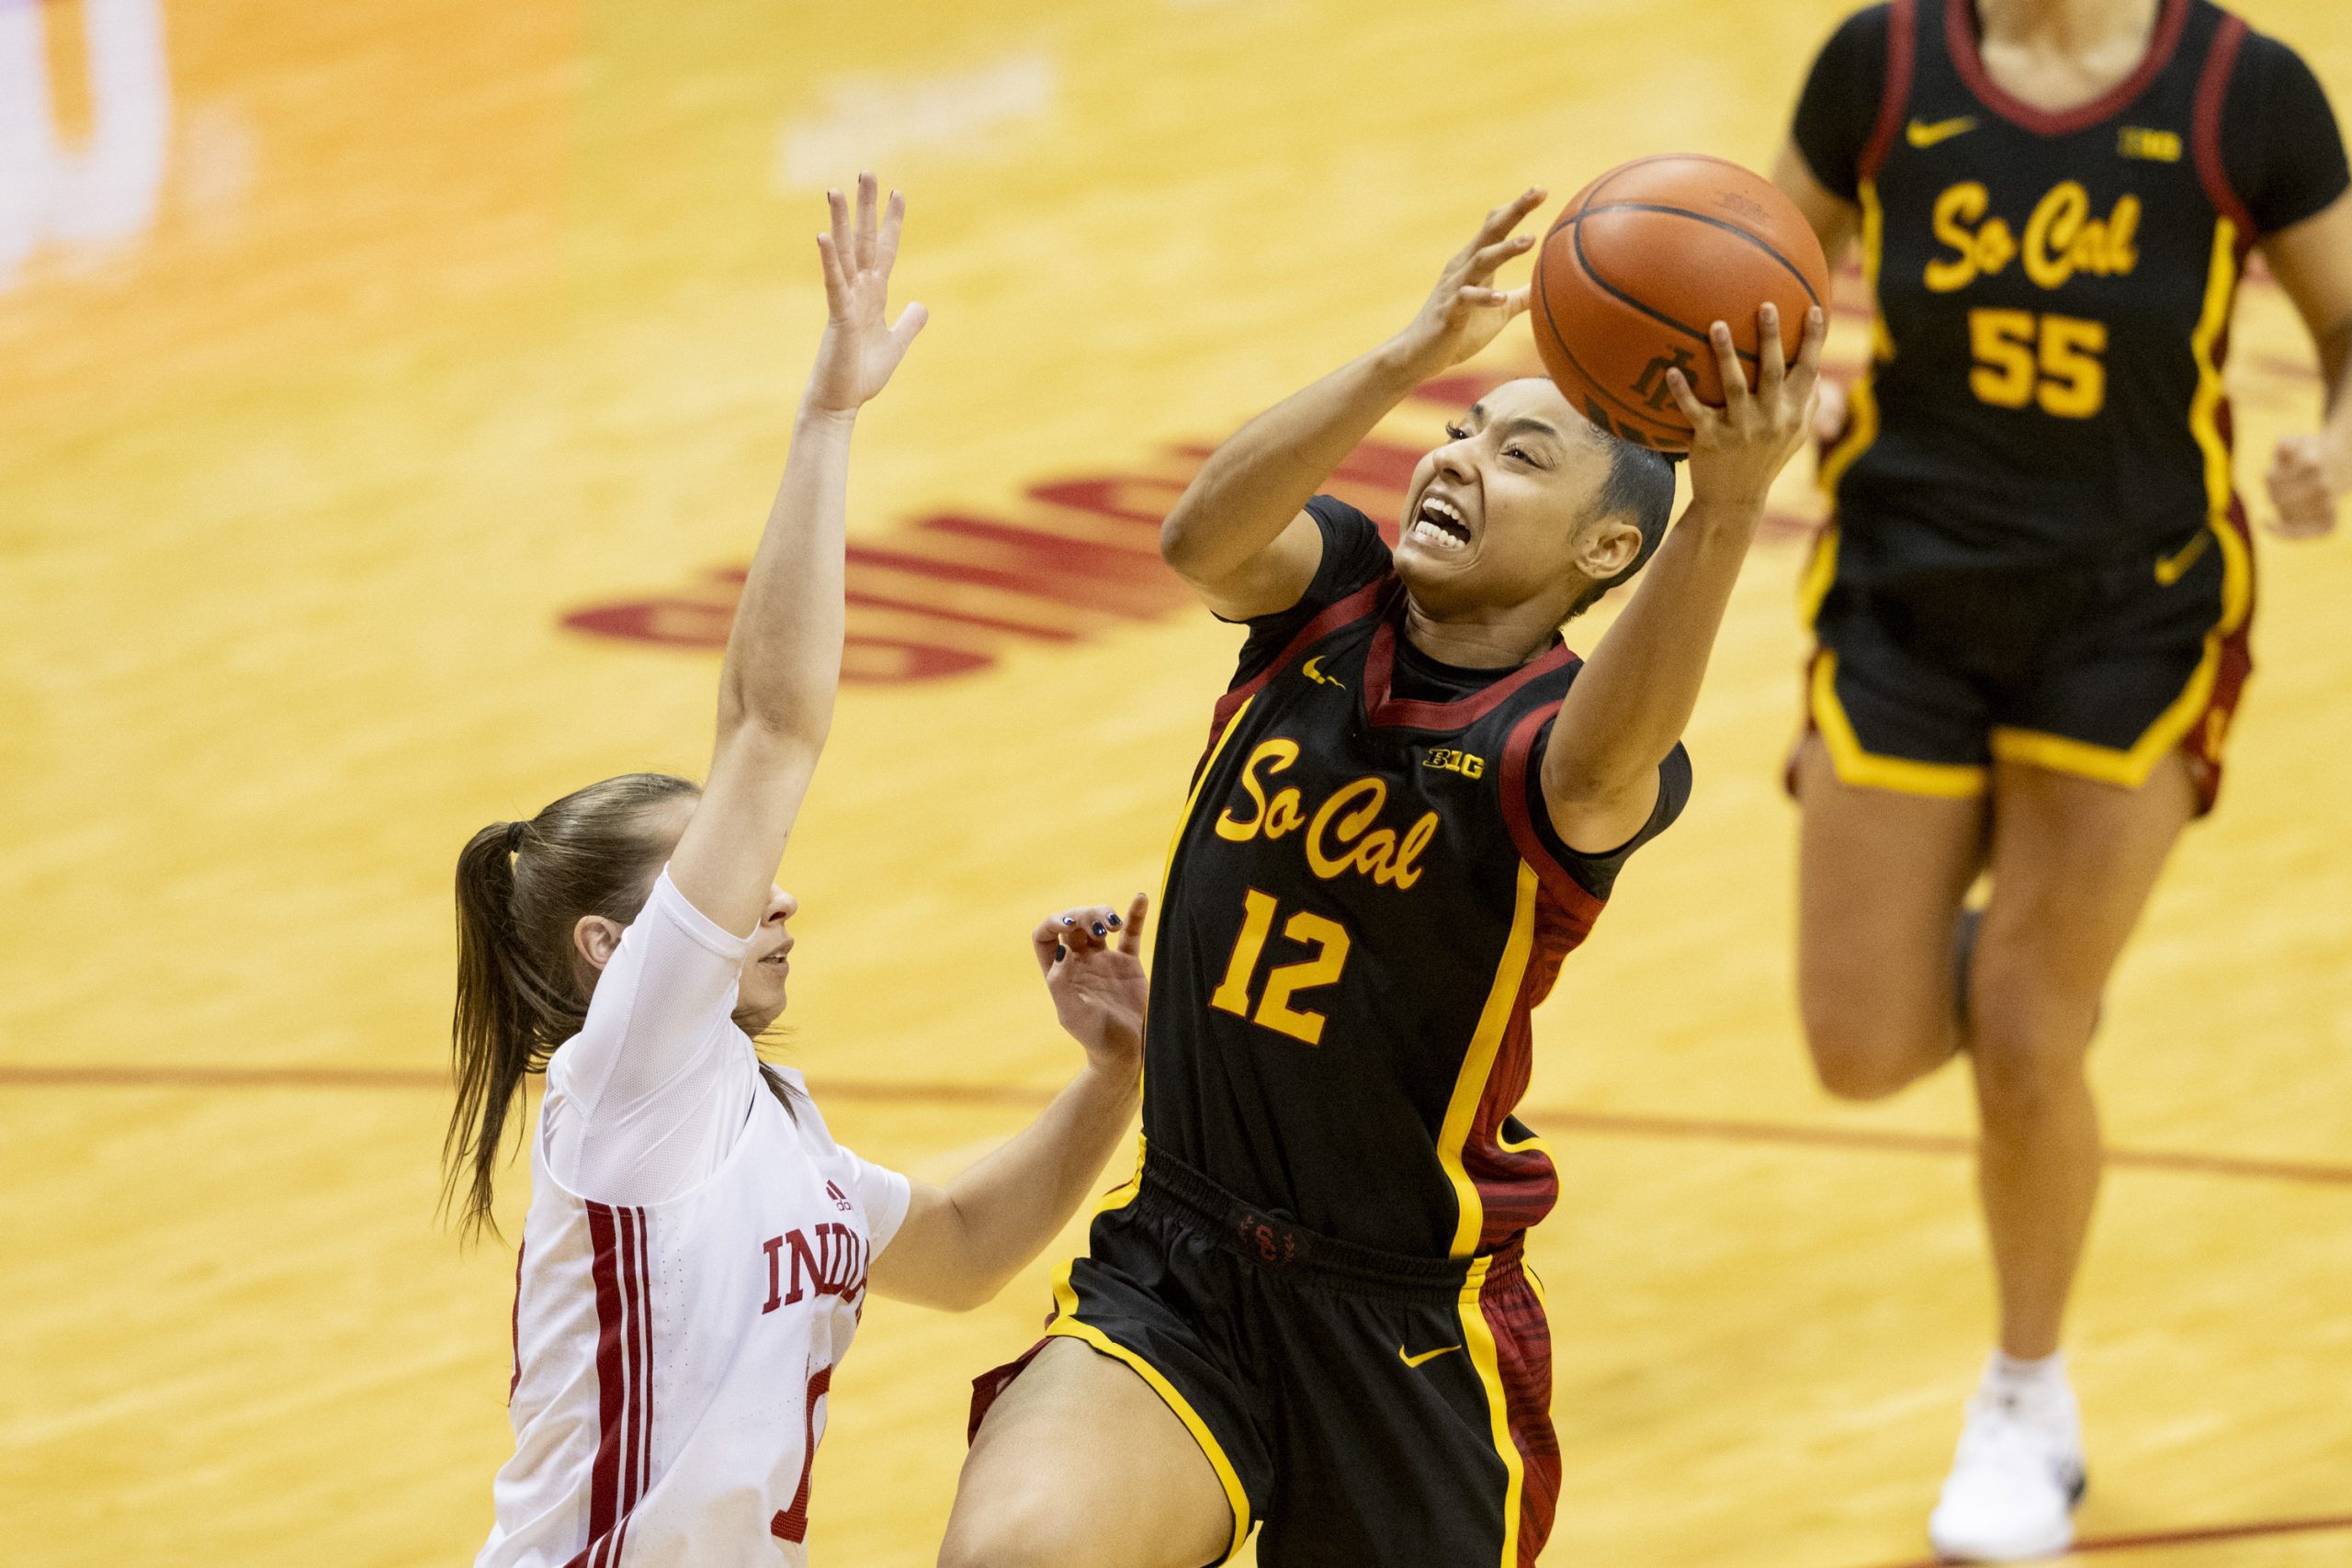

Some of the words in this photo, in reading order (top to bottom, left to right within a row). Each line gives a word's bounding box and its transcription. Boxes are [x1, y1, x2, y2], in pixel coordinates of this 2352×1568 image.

[1922, 179, 2020, 294] So
[2022, 178, 2142, 290] Cal
[1967, 305, 2109, 420] 55
[1215, 737, 1306, 842] So
[1306, 775, 1441, 890] Cal
[1208, 886, 1352, 1047] 12
